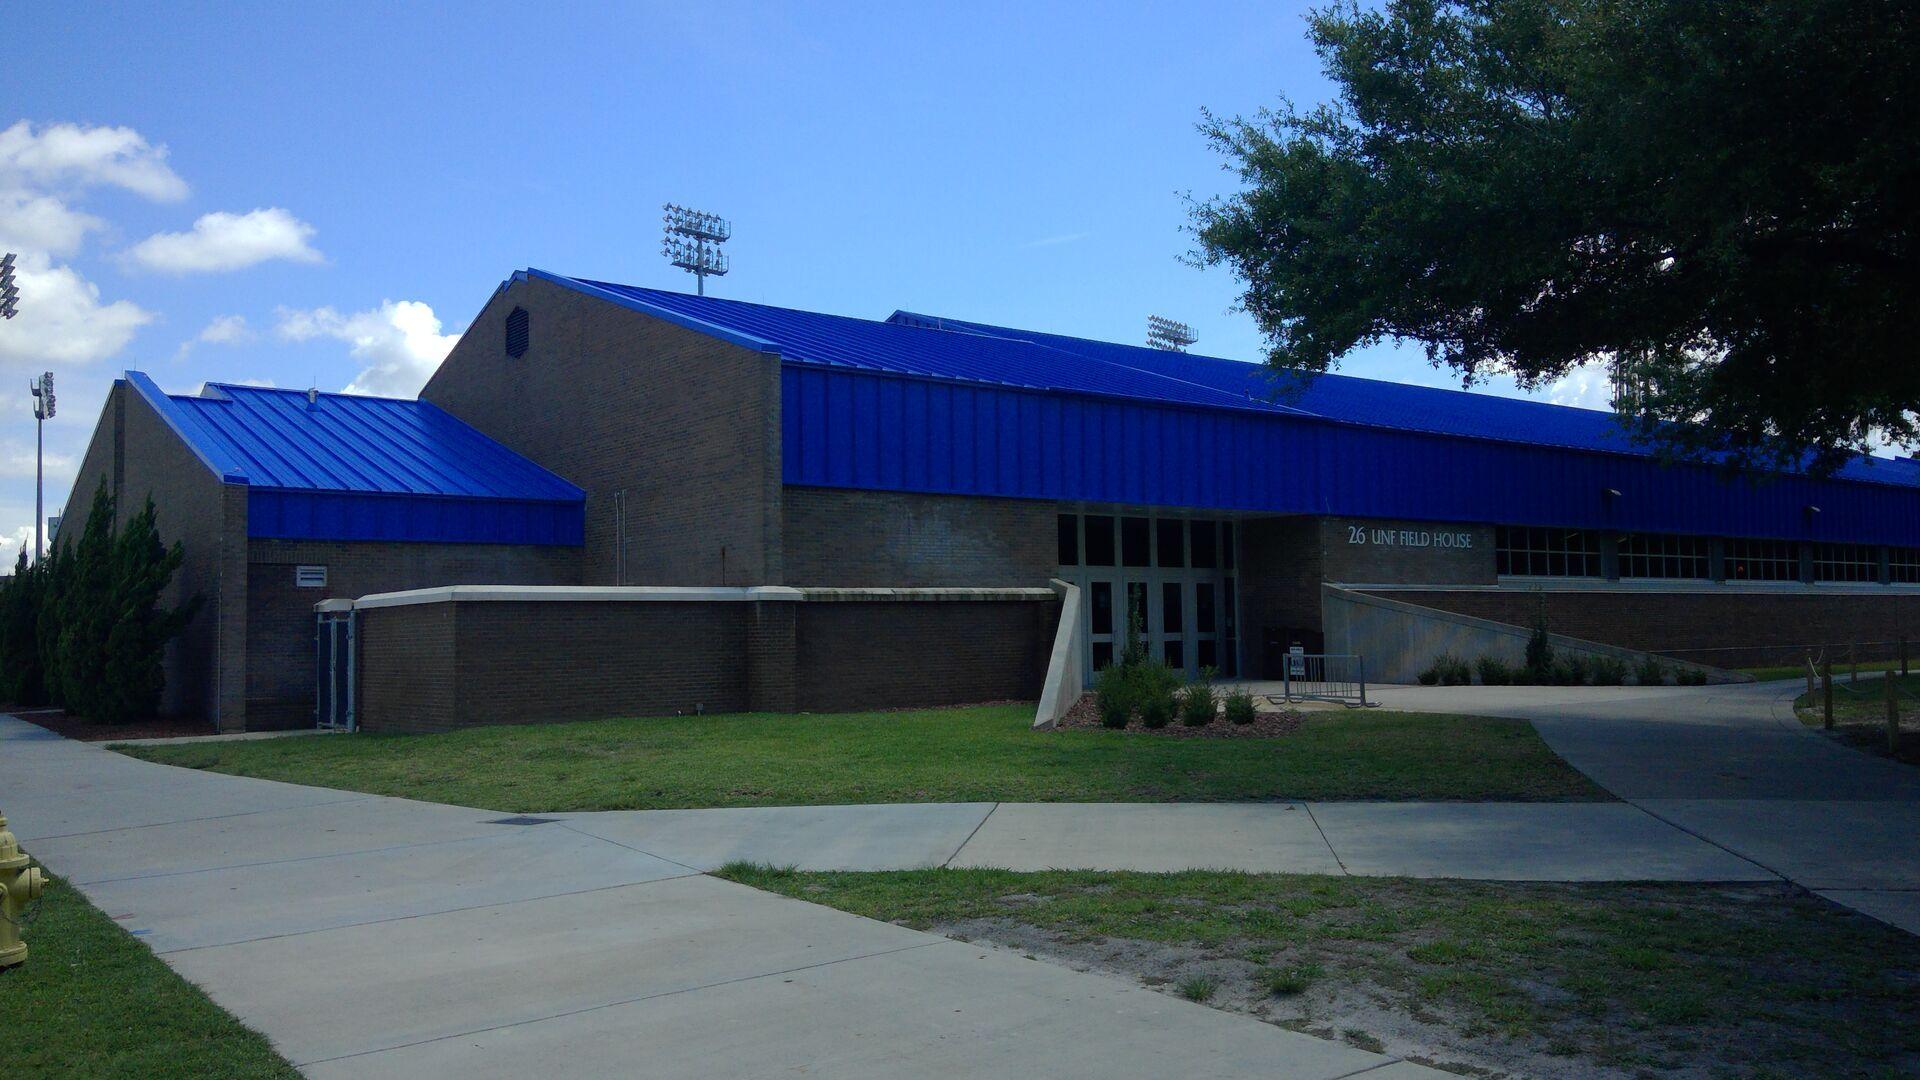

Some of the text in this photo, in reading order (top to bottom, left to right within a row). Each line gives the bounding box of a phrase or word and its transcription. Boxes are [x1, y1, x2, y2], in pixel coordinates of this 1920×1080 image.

[1348, 526, 1472, 548] 26 UNF FIELD HOUSE
